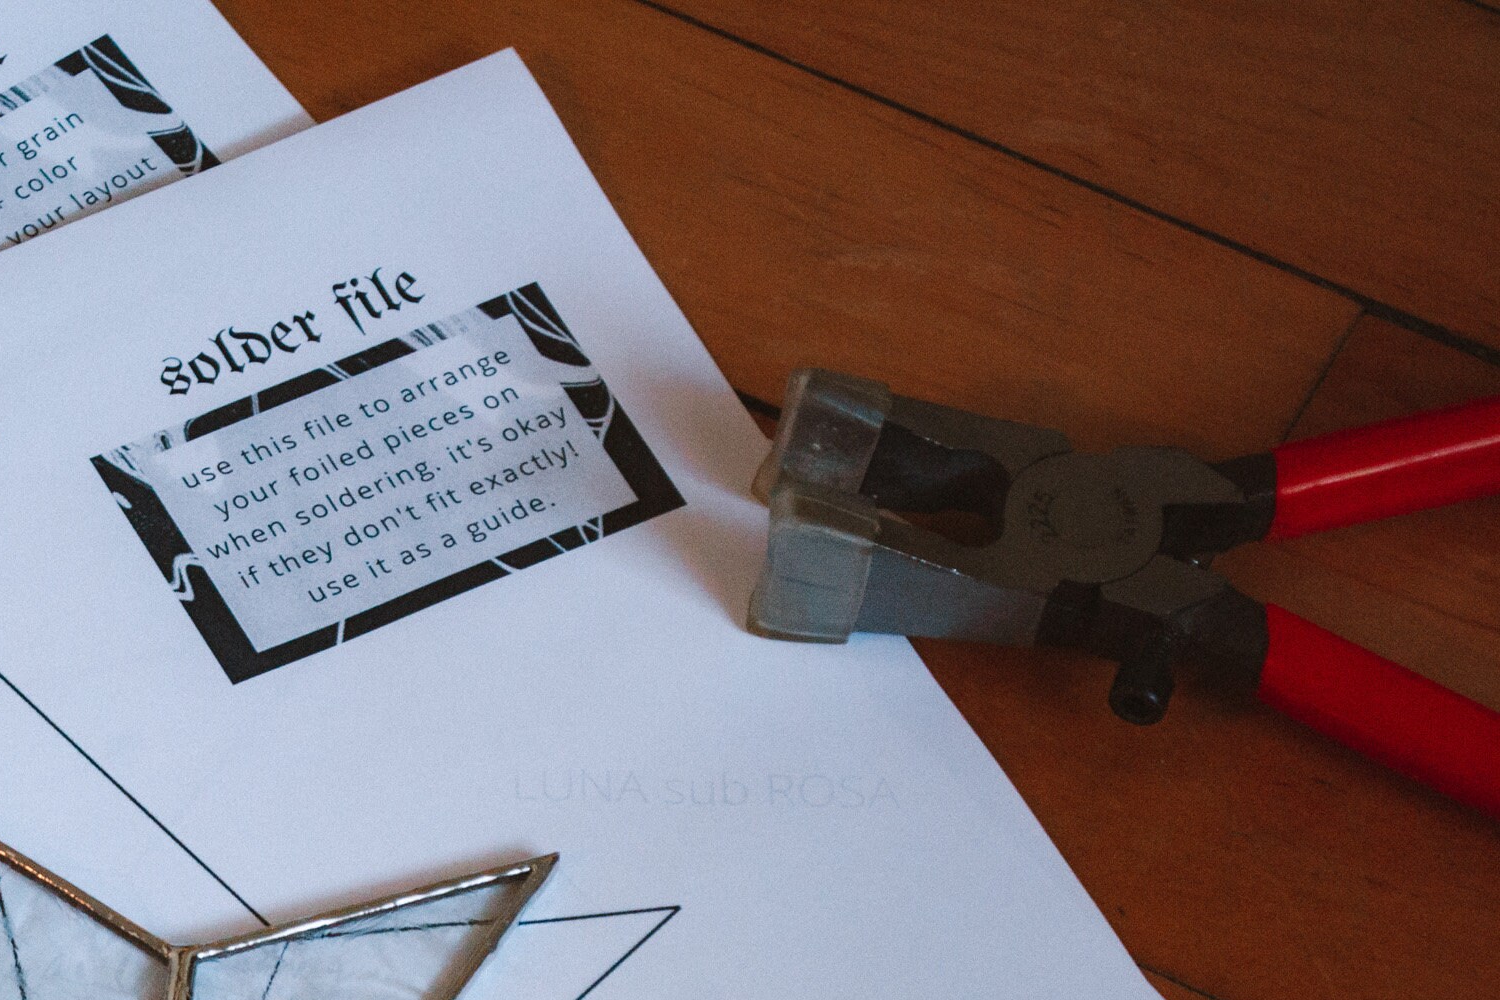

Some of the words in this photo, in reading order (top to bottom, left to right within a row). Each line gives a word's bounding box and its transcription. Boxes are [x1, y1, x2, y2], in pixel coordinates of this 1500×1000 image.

[13, 155, 77, 200] color
[15, 112, 84, 161] grain
[72, 153, 158, 212] layout
[159, 309, 323, 397] solder
[331, 267, 426, 335] file
[180, 460, 233, 489] use
[239, 434, 297, 465] this
[303, 413, 353, 440] file
[357, 398, 390, 418] to
[399, 350, 511, 403] arrange
[212, 479, 278, 522] your
[288, 438, 375, 487] foiled
[381, 404, 474, 455] pieces
[482, 387, 519, 409] on
[205, 520, 287, 559] when
[294, 460, 441, 526] soldering.
[445, 436, 493, 464] it's
[501, 406, 566, 442] okay
[237, 564, 260, 589] if
[267, 540, 332, 577] they
[343, 504, 421, 547] don't
[425, 488, 462, 512] fit
[467, 439, 579, 495] exactly!
[306, 572, 360, 603] use
[364, 558, 392, 578] it
[398, 542, 432, 565] as
[439, 532, 457, 549] a
[465, 497, 556, 543] guide.
[512, 767, 650, 804] LUNA
[662, 769, 751, 806] sub
[767, 772, 902, 810] ROSA
